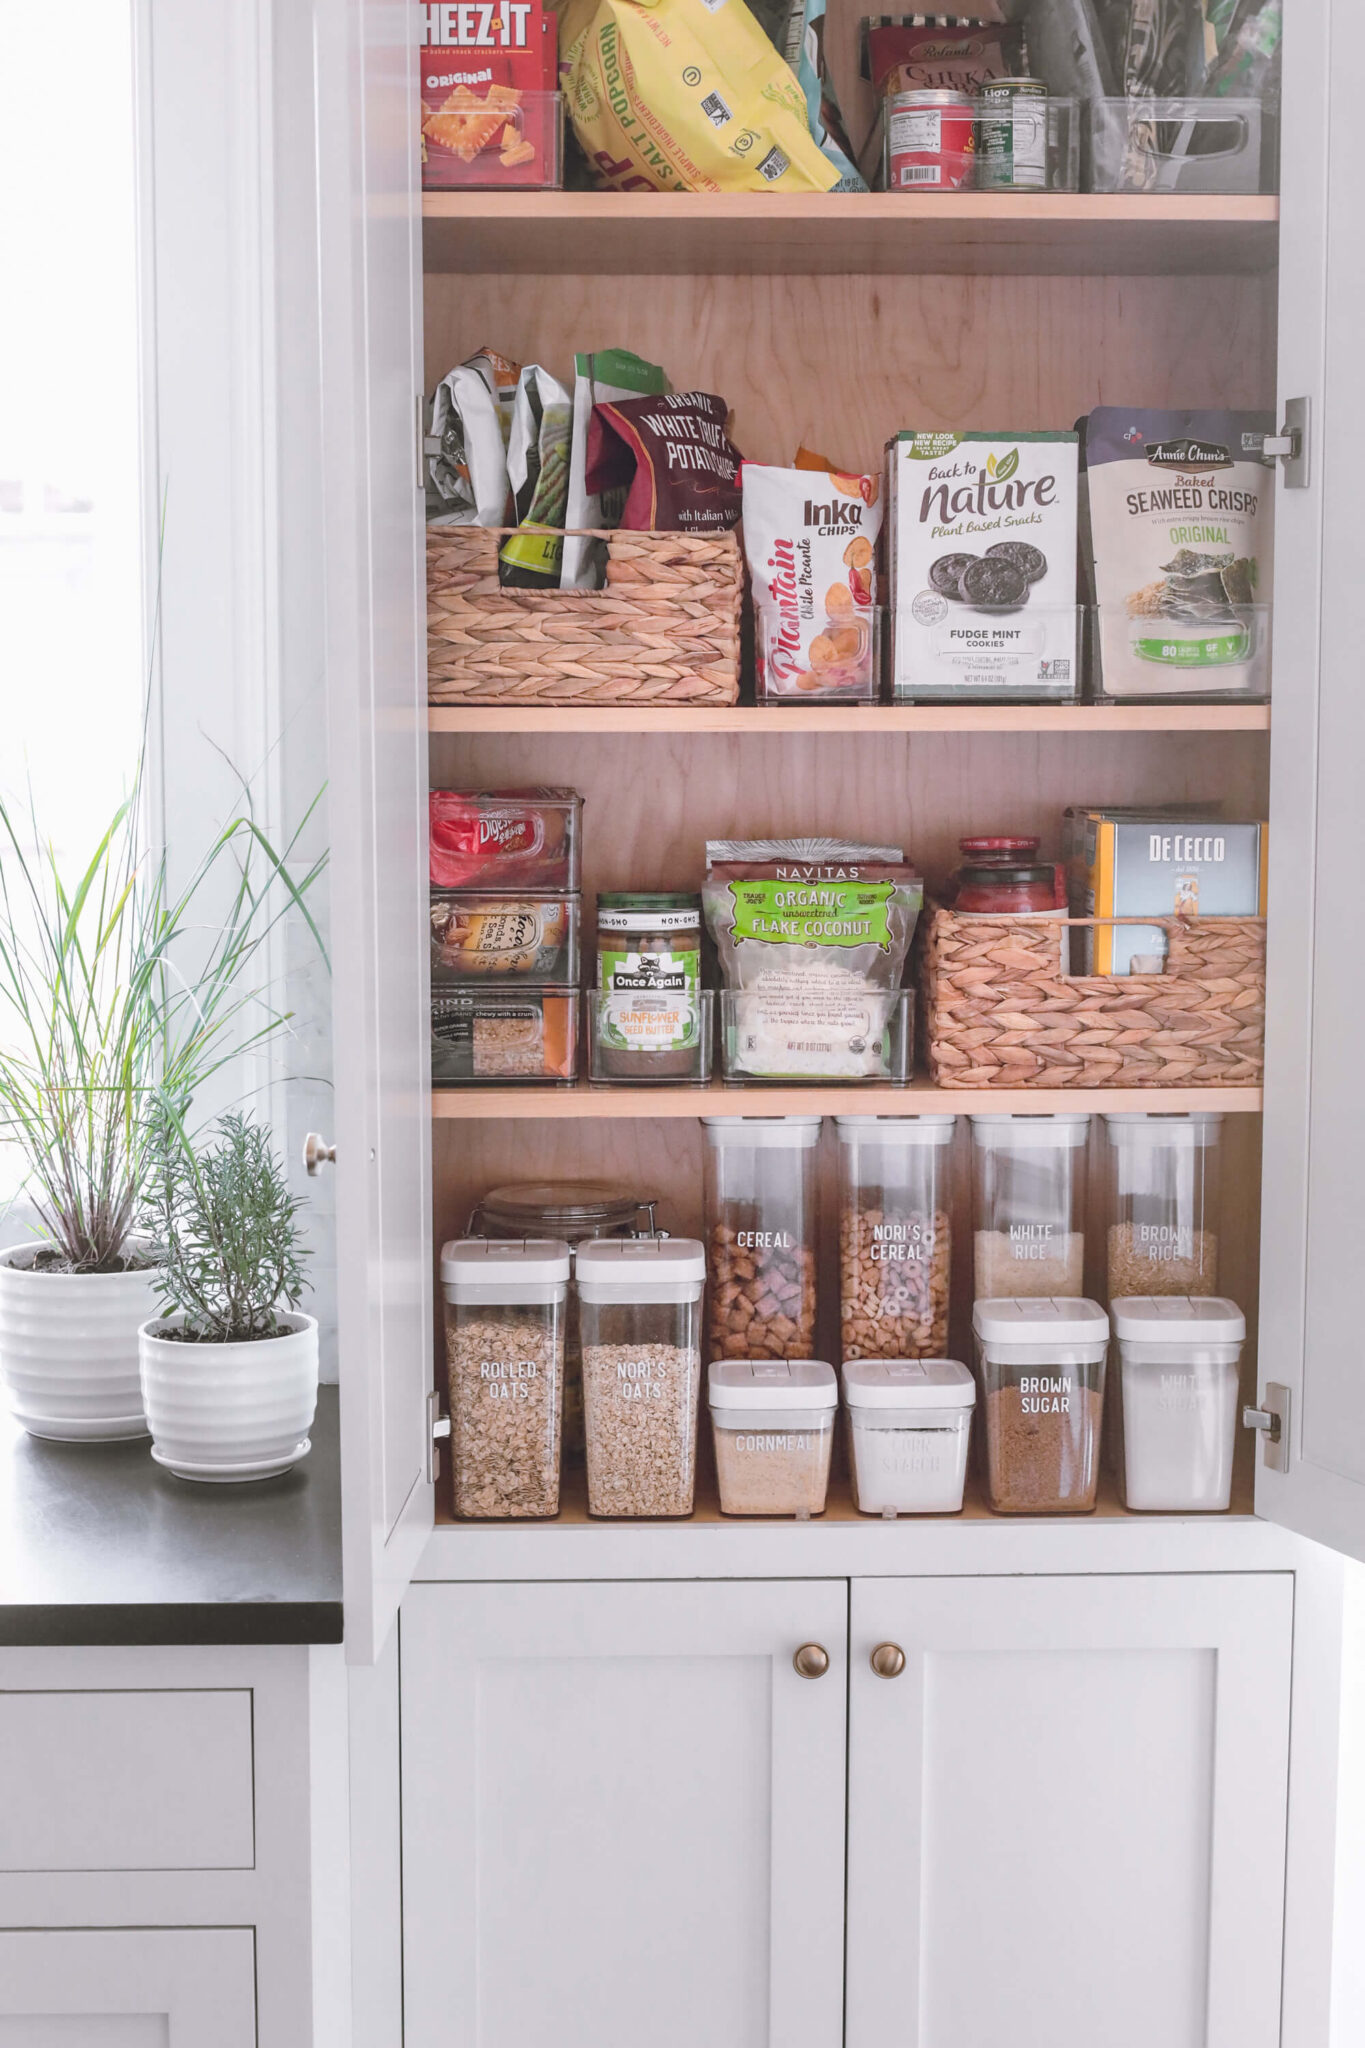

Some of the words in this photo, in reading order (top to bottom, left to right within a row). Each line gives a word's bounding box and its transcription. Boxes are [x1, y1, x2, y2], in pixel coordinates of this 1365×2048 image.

[600, 22, 636, 128] POPCORN
[631, 132, 674, 179] SALT
[665, 392, 714, 415] ORGANIC
[639, 414, 699, 440] WHITE
[1149, 445, 1186, 461] Annie
[1188, 444, 1226, 461] Chun's
[928, 462, 963, 481] Back
[964, 461, 977, 475] to
[1174, 475, 1216, 488] Baked
[919, 468, 1057, 524] nature
[1126, 489, 1203, 515] SEAWEED
[1208, 489, 1258, 517] CRISPS
[694, 509, 724, 521] Italian
[804, 499, 863, 526] Inka
[817, 525, 857, 537] CHIPS
[931, 522, 964, 539] Plant
[966, 516, 1001, 533] Based
[1003, 511, 1043, 528] Snacks
[1169, 526, 1232, 545] ORIGINAL
[797, 537, 815, 588] Picante
[767, 538, 808, 680] Plantain
[950, 629, 989, 639] FUDGE
[992, 629, 1021, 639] MINT
[966, 640, 1005, 648] COOKIES
[1162, 645, 1177, 657] 80
[1174, 835, 1225, 862] CECCO
[776, 866, 860, 879] NAVITAS
[775, 890, 847, 908] ORGANIC
[661, 916, 696, 925] NON-GMO
[783, 908, 839, 918] unsweetened
[752, 918, 800, 936] FLAKE
[804, 920, 872, 937] COCONUT
[616, 977, 646, 987] Once
[647, 976, 683, 989] Again
[620, 1011, 680, 1024] SUNFLOWER
[624, 1024, 643, 1035] SEED
[645, 1024, 675, 1035] BUTTER
[737, 1231, 791, 1249] CEREAL
[874, 1224, 921, 1241] NORI'S
[1010, 1224, 1053, 1241] WHITE
[1140, 1226, 1190, 1242] BROWN
[870, 1245, 923, 1261] CEREAL
[1015, 1244, 1047, 1260] RICE
[1149, 1246, 1181, 1261] RICE
[481, 1362, 537, 1379] ROLLED
[617, 1362, 667, 1379] NORI'S
[489, 1382, 529, 1399] OATS
[622, 1382, 662, 1399] OATS
[1020, 1377, 1072, 1394] BROWN
[1021, 1397, 1070, 1413] SUGAR
[736, 1434, 814, 1452] CORNMEAL
